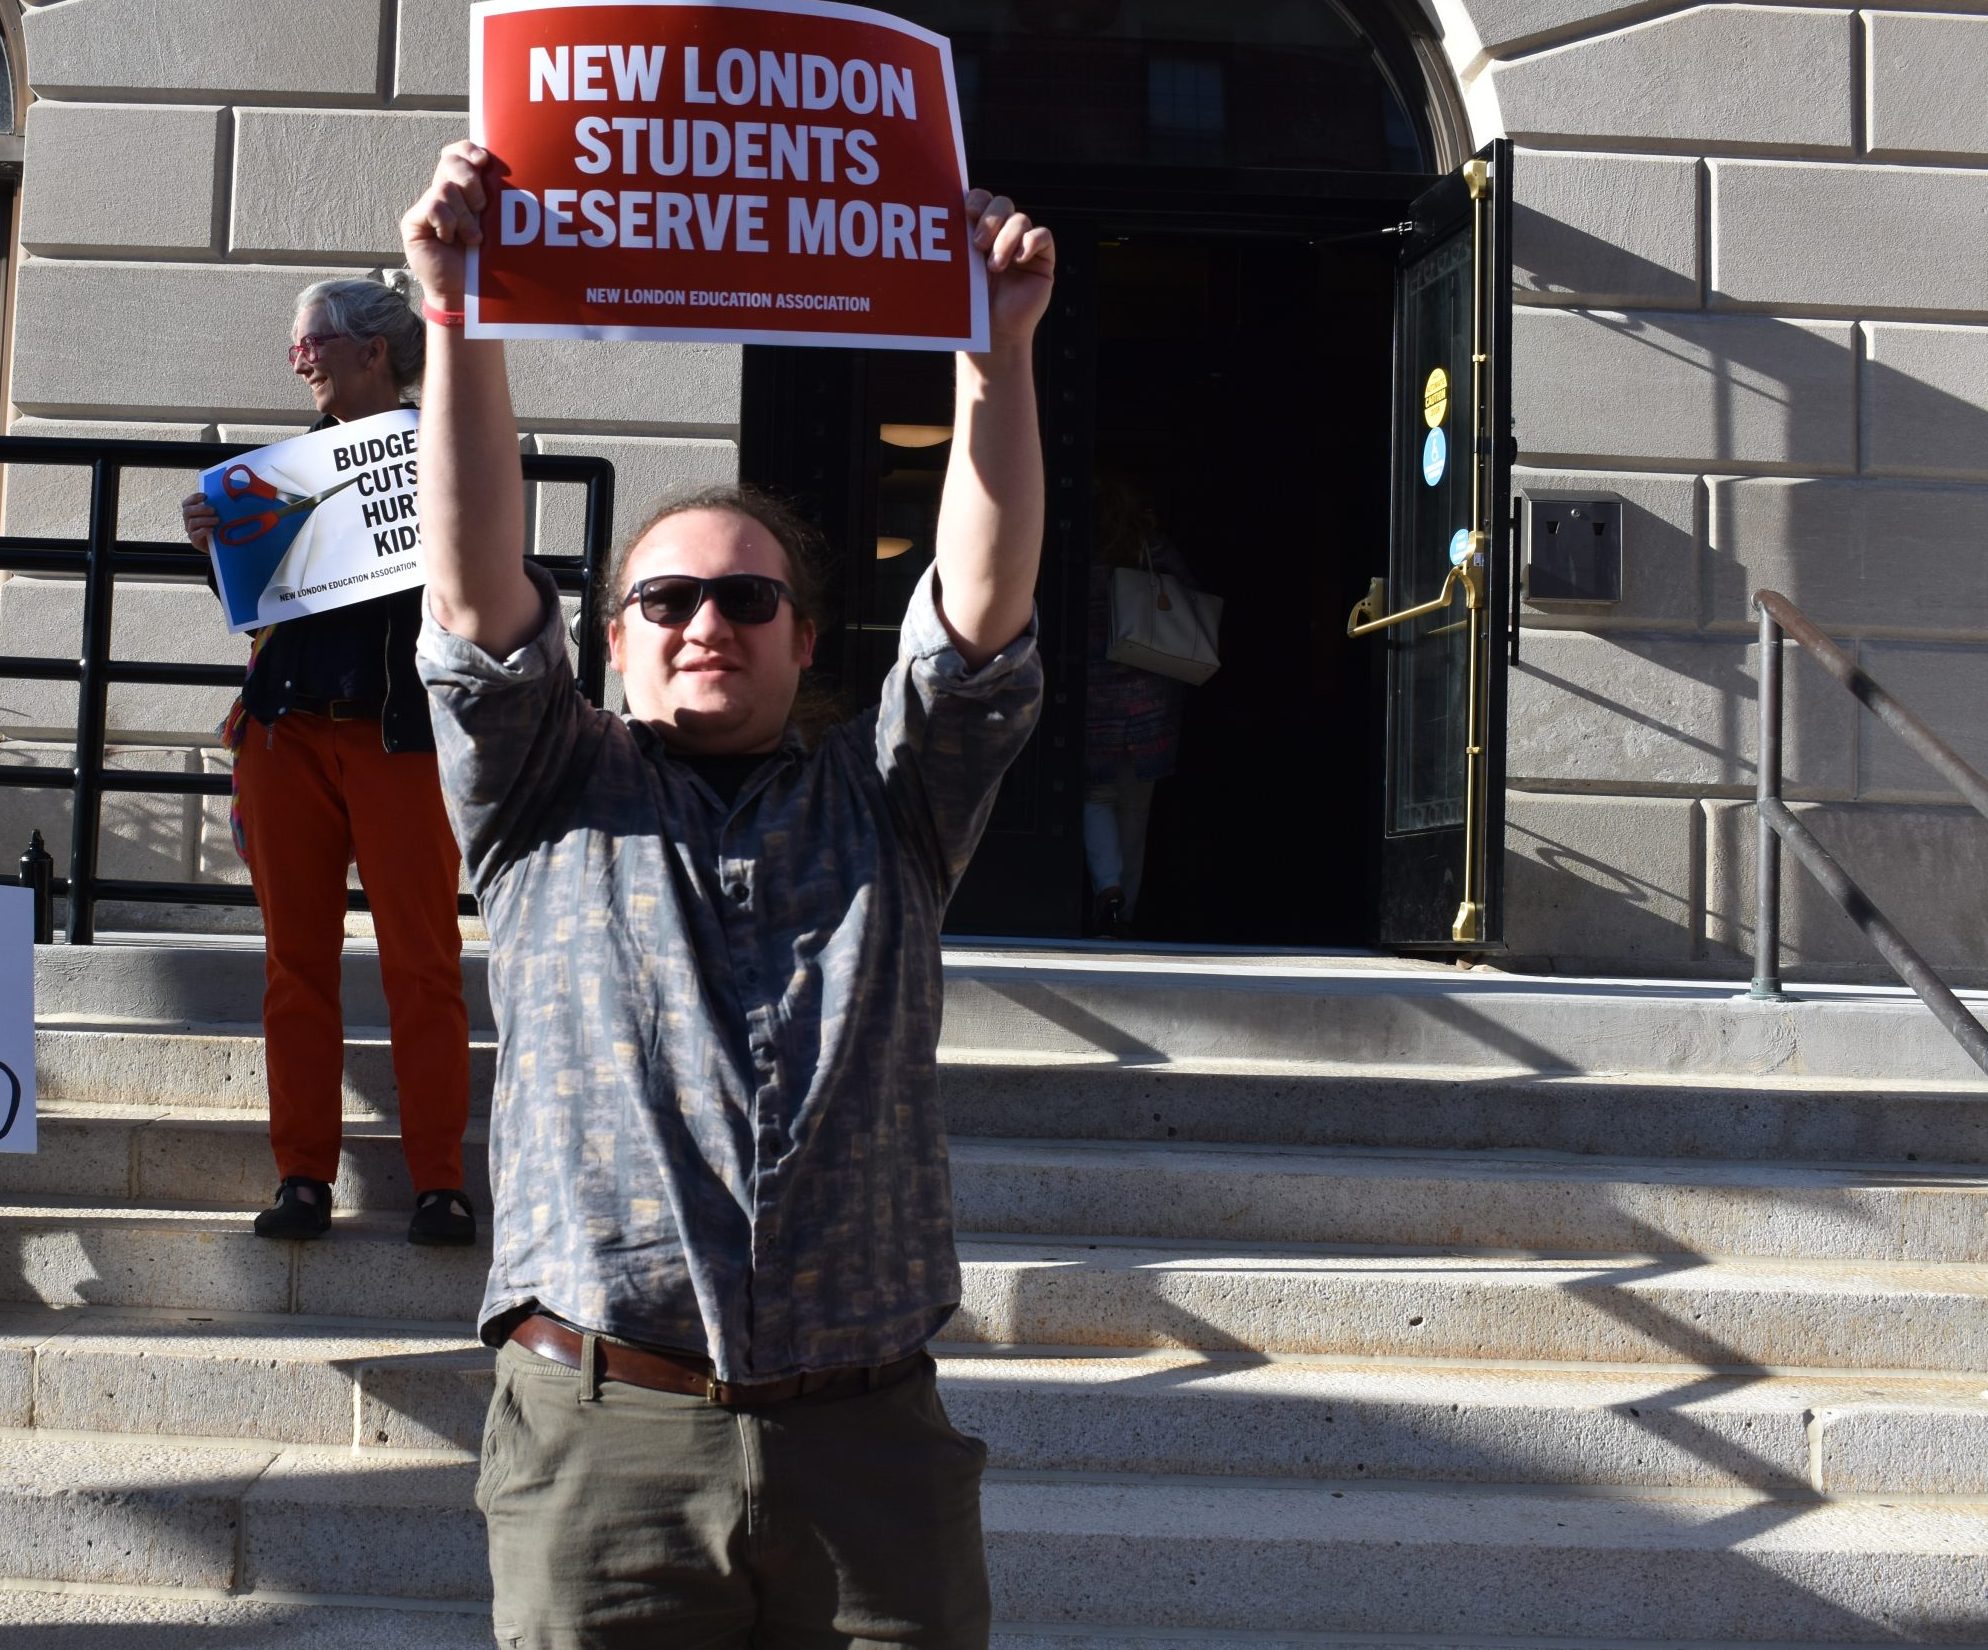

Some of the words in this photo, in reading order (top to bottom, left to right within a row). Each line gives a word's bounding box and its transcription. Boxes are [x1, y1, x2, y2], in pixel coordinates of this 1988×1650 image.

[530, 45, 666, 103] NEW
[684, 46, 917, 121] LONDON
[574, 116, 880, 186] STUDENTS
[500, 189, 769, 253] DESERVE
[788, 198, 952, 262] MORE
[586, 287, 621, 304] NEW
[624, 288, 685, 305] LONDON
[689, 290, 772, 308] EDUCATION
[775, 293, 870, 312] ASSOCIATION
[333, 429, 419, 472] BUDGE
[356, 460, 418, 497] CUTS
[361, 491, 418, 529] HUR
[279, 591, 297, 603] NEW
[298, 583, 328, 598] LONDON
[328, 573, 370, 590] EDUCATION
[370, 560, 418, 579] ASSOCIATION
